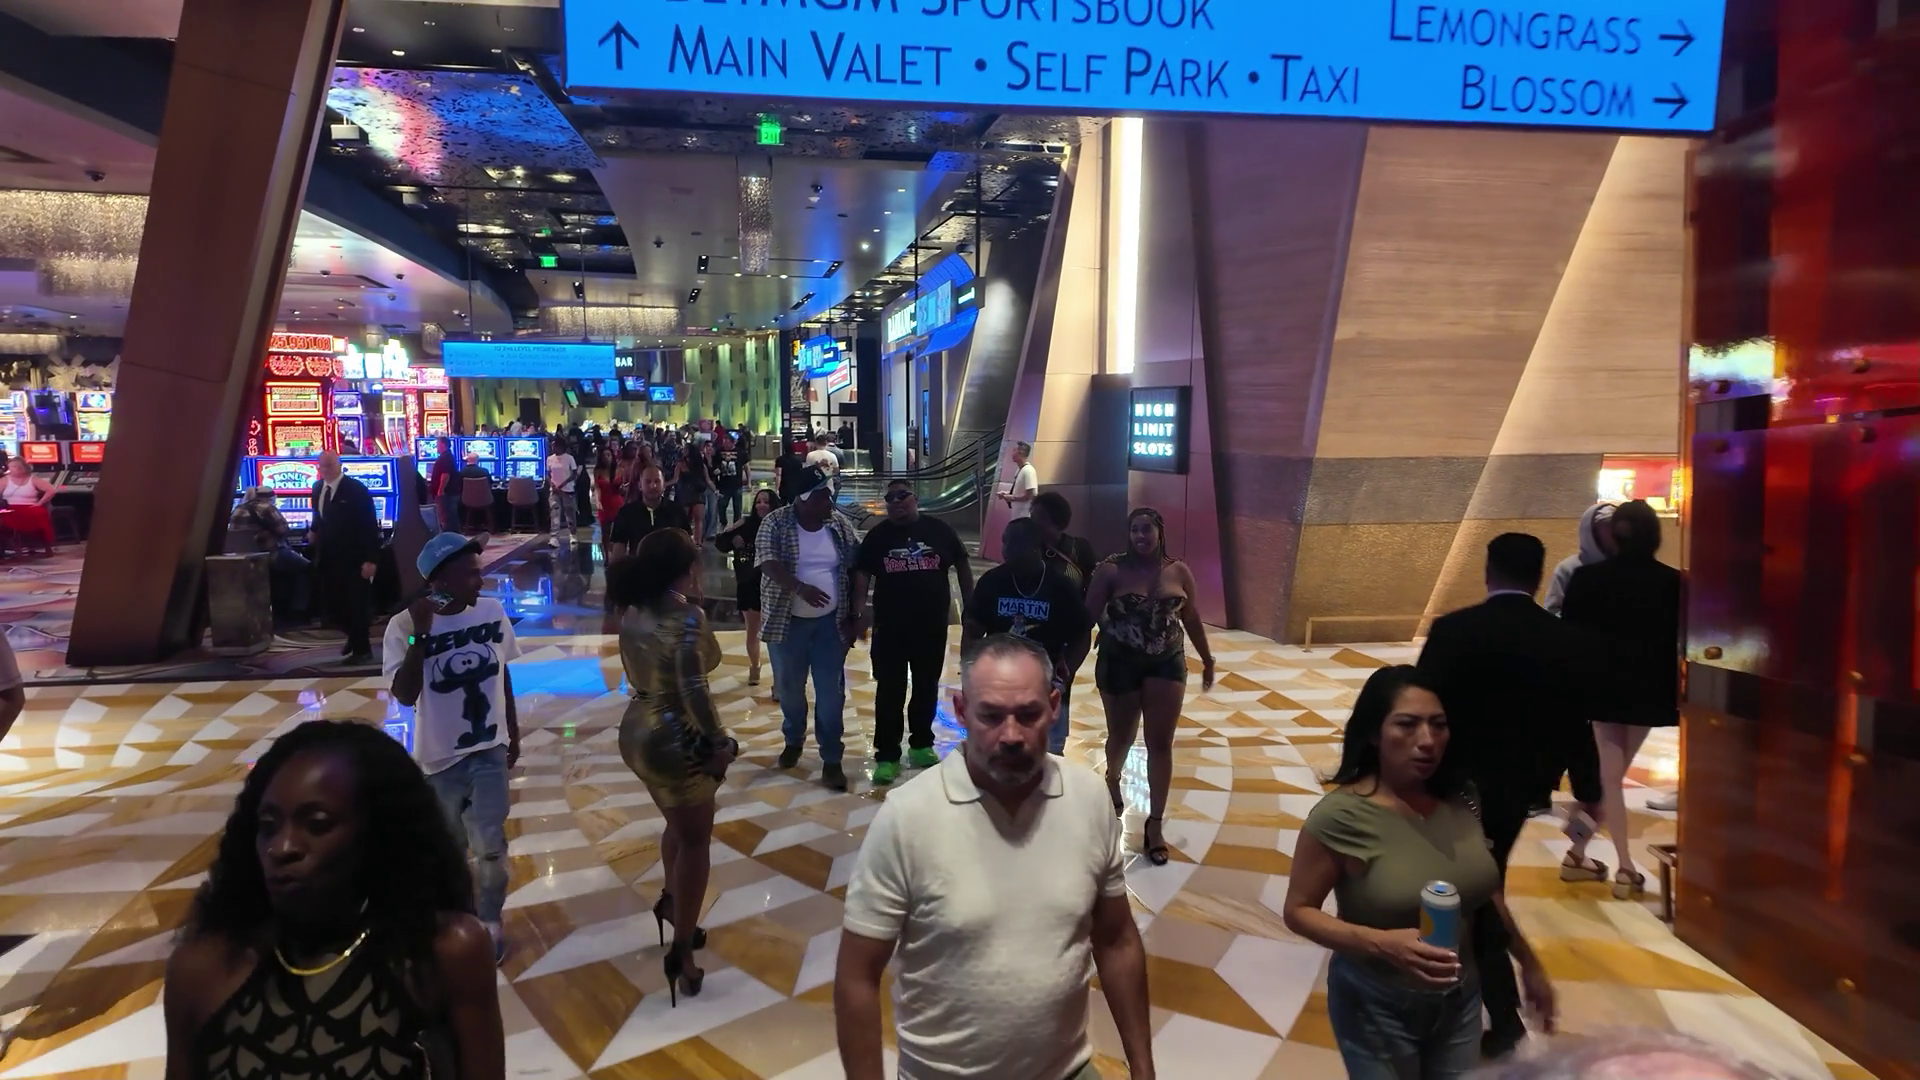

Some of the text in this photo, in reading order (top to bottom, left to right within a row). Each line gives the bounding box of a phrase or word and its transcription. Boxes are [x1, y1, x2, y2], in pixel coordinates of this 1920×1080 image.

[1389, 0, 1642, 54] LEMONGRASS
[668, 23, 1359, 105] MAIN VALET SELF PARK TAXI
[1461, 64, 1636, 118] BLOSSOM
[615, 357, 633, 367] BAR
[1134, 403, 1175, 417] HIGH
[1133, 422, 1174, 437] LIMIT
[1133, 441, 1173, 457] SLOTS
[273, 472, 307, 482] BONUS
[275, 481, 308, 489] POKER
